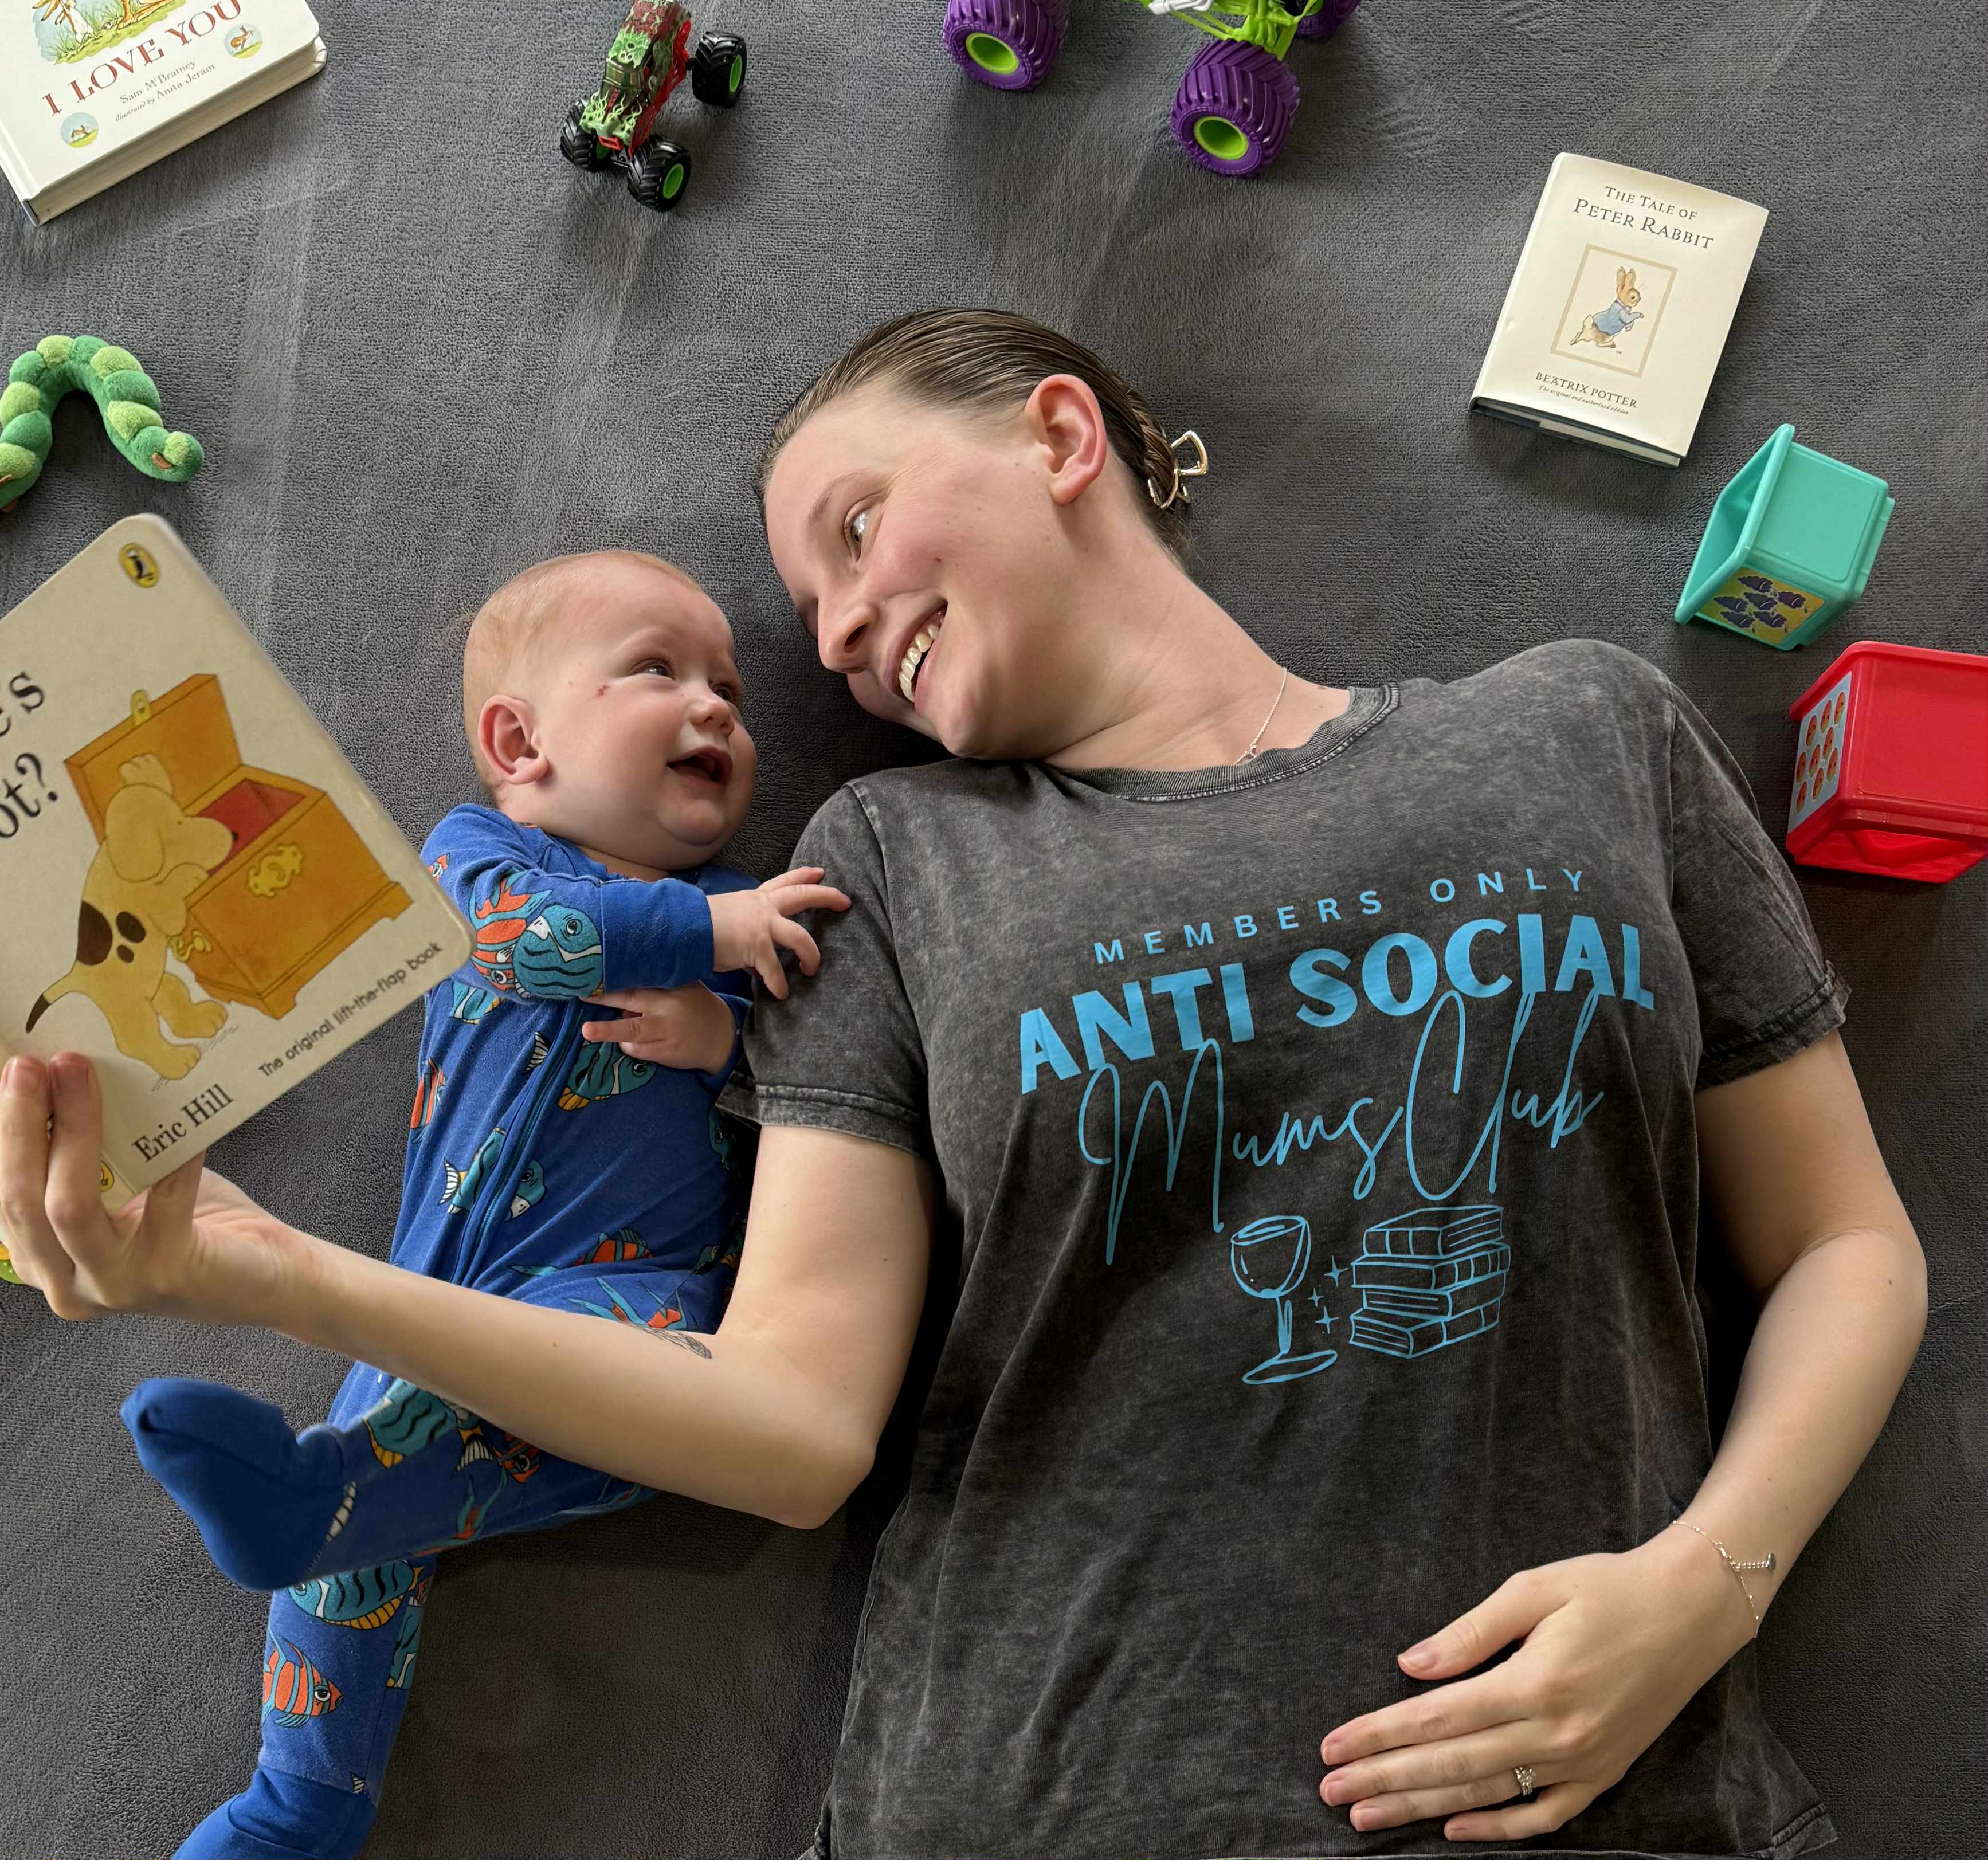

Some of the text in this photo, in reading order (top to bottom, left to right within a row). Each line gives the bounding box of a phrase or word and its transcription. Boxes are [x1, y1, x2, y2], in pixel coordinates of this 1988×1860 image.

[42, 0, 241, 117] I LOVE YOU
[156, 82, 183, 100] Anita
[185, 64, 216, 84] Jeram
[120, 88, 143, 104] Sam
[1572, 198, 1715, 249] PETER RABBIT
[1605, 186, 1698, 221] THE TALE OF
[1535, 371, 1638, 409] BEATRIX POTTER
[1550, 388, 1572, 399] original
[1092, 868, 1584, 964] MEMBERS ONLY
[258, 941, 444, 1078] The original lift-the-flap book
[1018, 912, 1655, 1095] ANTI SOCIAL
[131, 1082, 234, 1164] Eric Hill
[1078, 990, 1605, 1266] Mums Club
